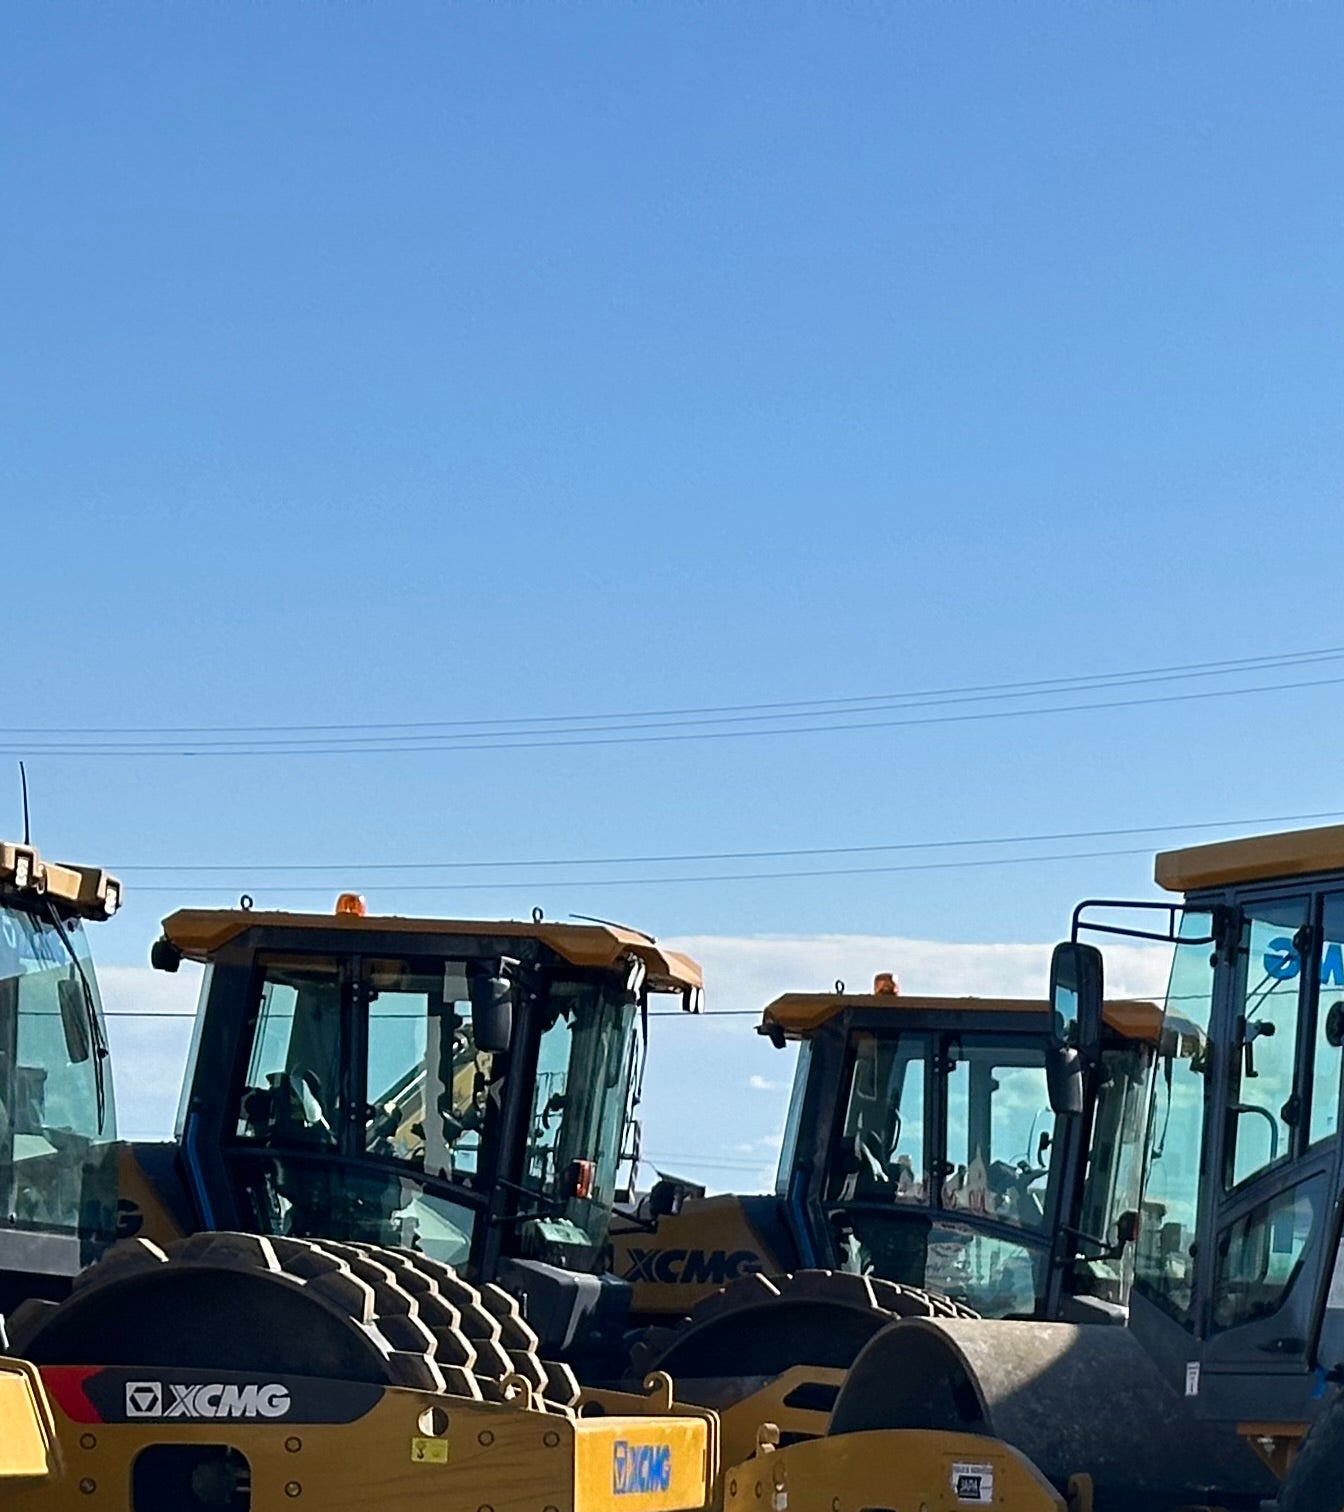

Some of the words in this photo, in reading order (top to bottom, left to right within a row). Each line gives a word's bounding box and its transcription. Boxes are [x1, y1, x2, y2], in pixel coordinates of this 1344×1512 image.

[623, 1249, 763, 1284] XCMG
[163, 1383, 291, 1417] XCMG
[624, 1445, 670, 1493] XCMG
